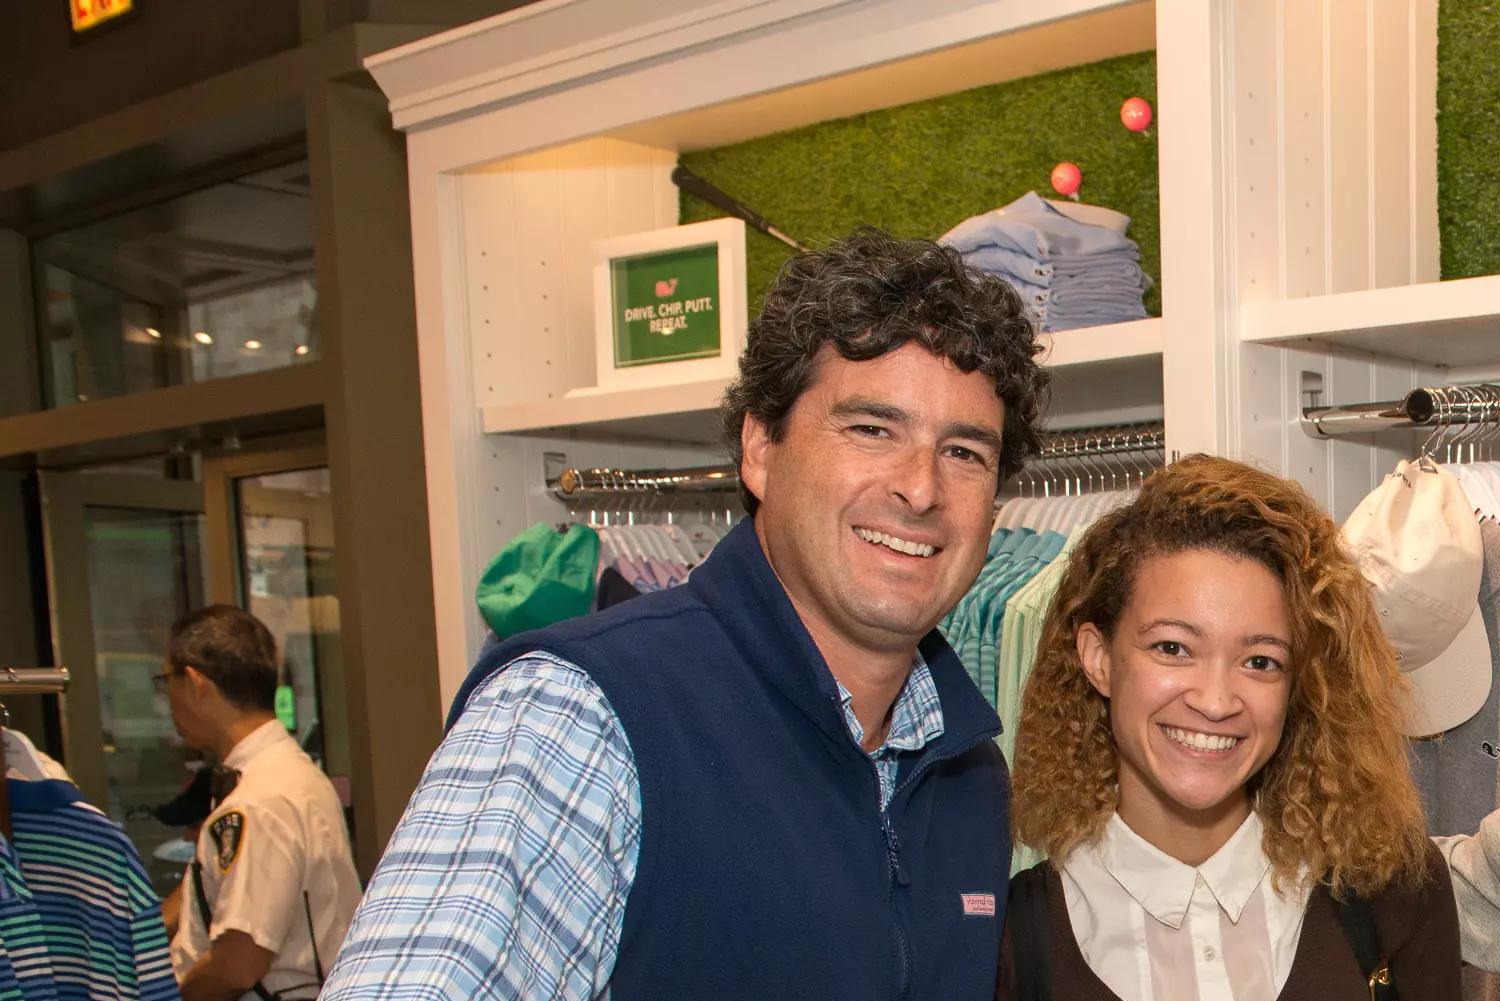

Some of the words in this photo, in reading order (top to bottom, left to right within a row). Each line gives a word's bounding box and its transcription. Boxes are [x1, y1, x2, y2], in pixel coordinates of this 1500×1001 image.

[624, 305, 657, 322] DRIVE.
[658, 301, 683, 317] CHIP.
[685, 297, 713, 313] PUTT.
[649, 315, 688, 333] REPEAT.
